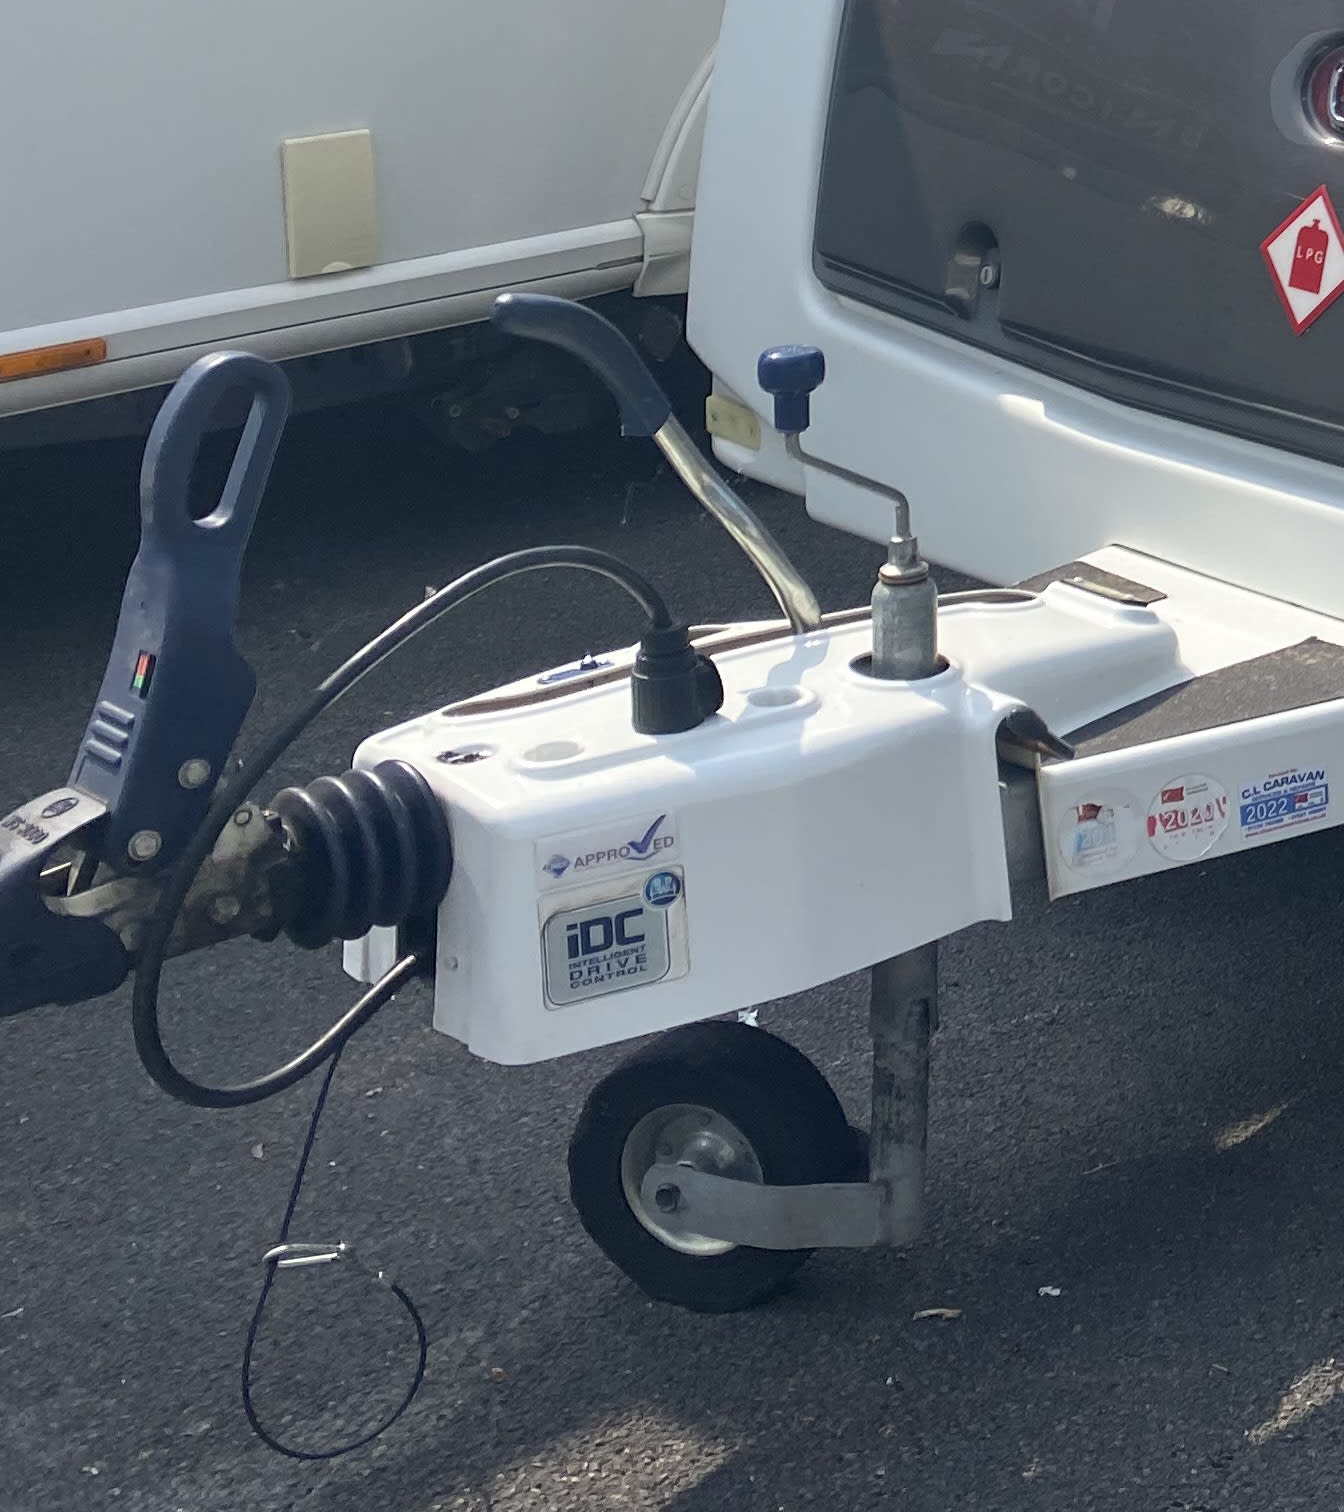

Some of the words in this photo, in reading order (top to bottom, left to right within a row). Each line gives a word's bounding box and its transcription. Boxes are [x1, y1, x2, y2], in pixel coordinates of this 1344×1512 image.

[1296, 245, 1325, 265] LPG
[1264, 770, 1325, 791] CARAVAN
[1246, 798, 1288, 823] 2022
[566, 908, 646, 960] iDC
[568, 944, 647, 970] INTELLIGENT
[569, 953, 648, 981] DRIVE
[570, 965, 649, 990] CONTROL
